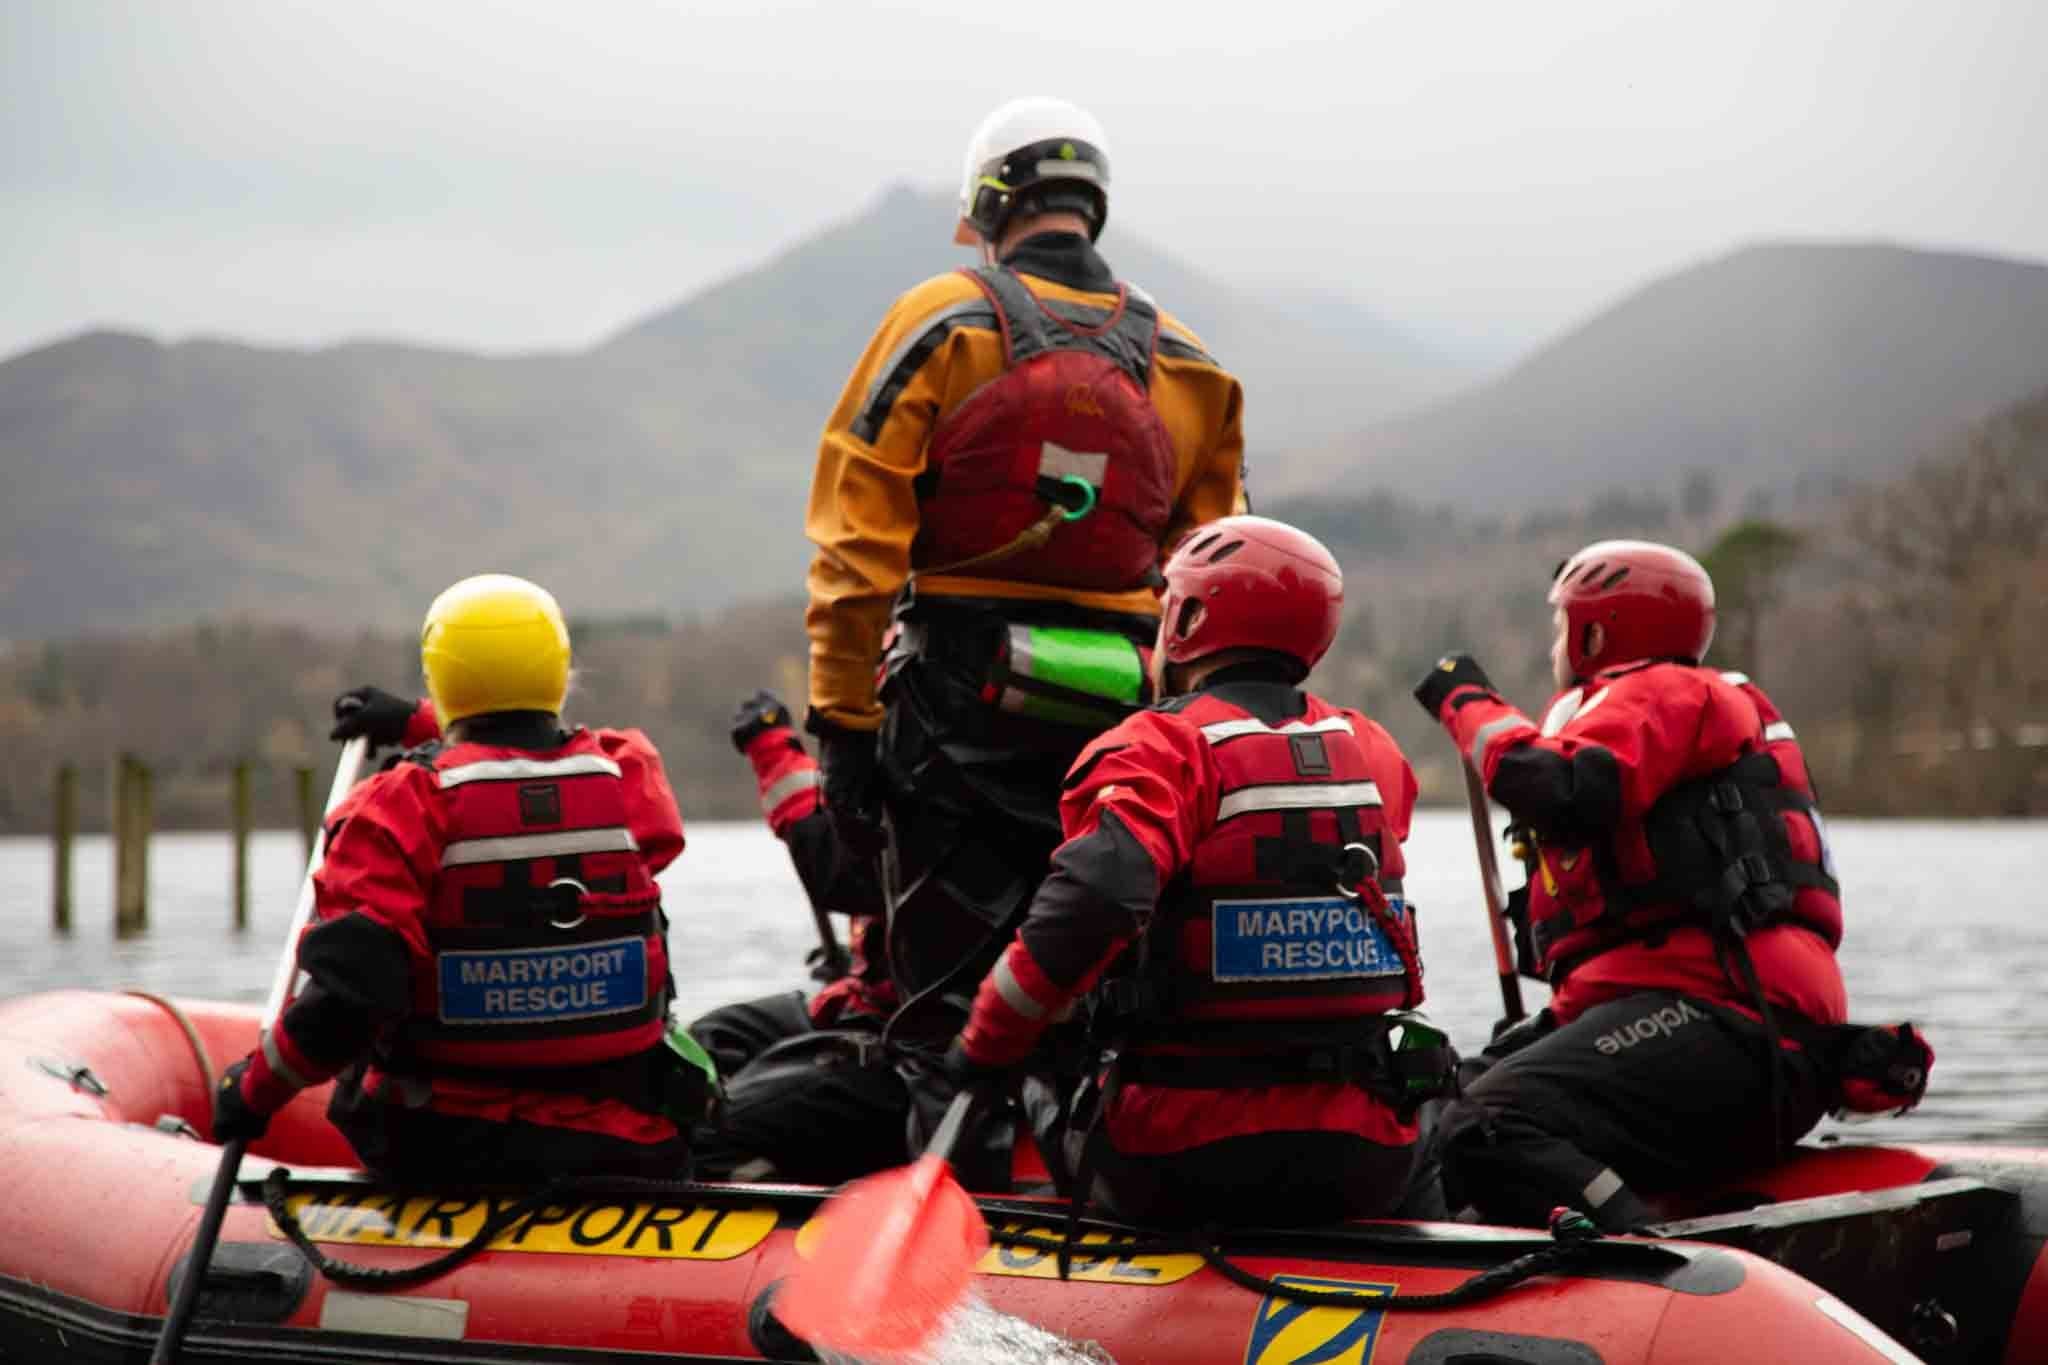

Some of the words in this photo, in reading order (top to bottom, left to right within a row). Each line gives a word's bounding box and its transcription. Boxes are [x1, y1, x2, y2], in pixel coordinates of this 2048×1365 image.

[1237, 908, 1378, 937] MARYPO
[461, 949, 625, 984] MARYPORT
[1262, 938, 1377, 968] RESCUE
[484, 981, 608, 1013] RESCUE
[1594, 1000, 1712, 1055] yclone
